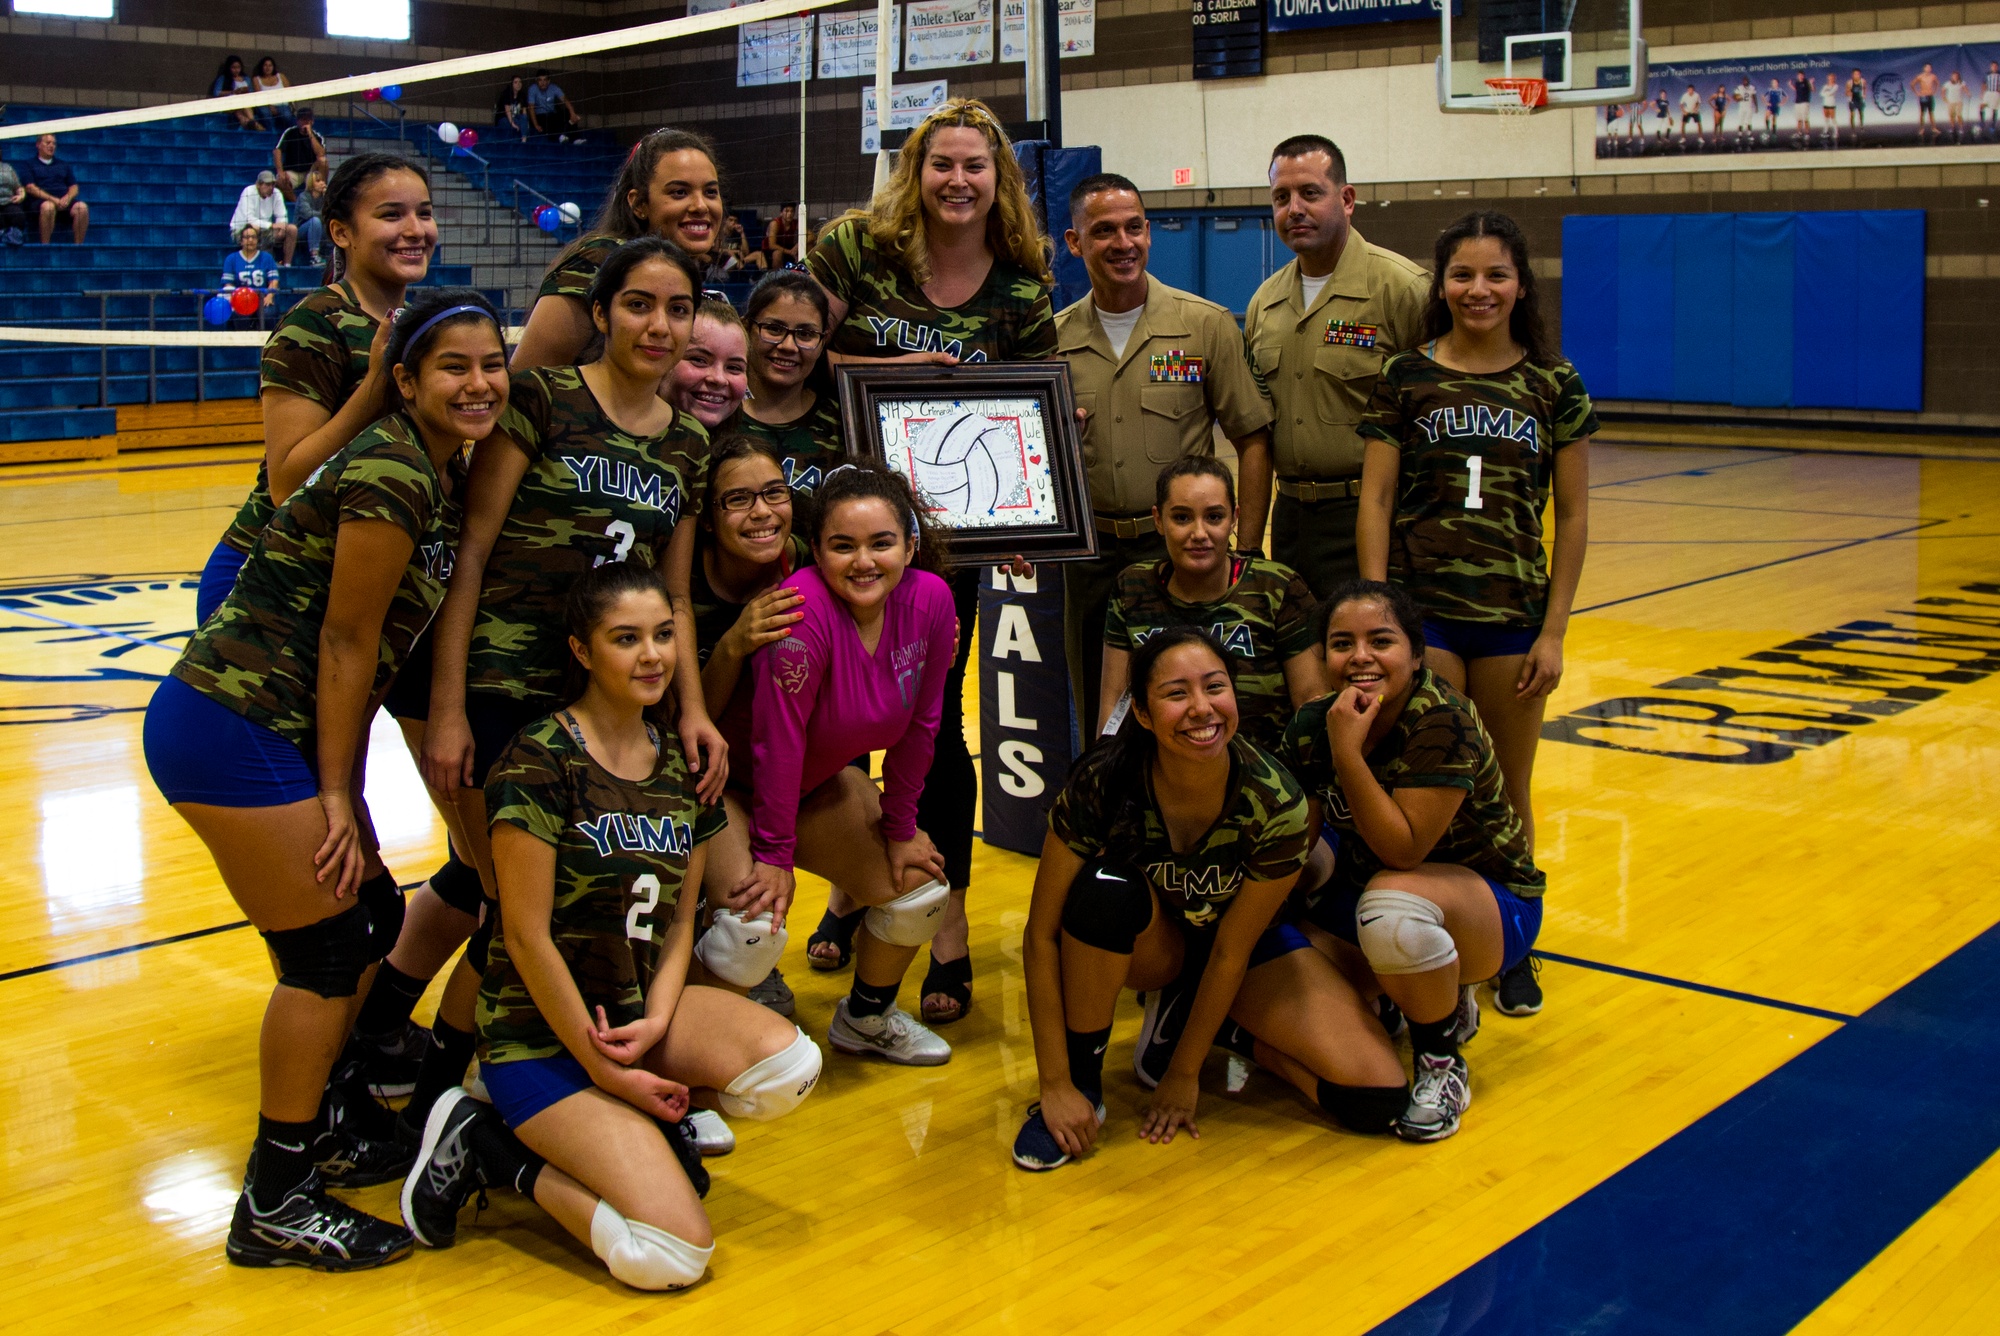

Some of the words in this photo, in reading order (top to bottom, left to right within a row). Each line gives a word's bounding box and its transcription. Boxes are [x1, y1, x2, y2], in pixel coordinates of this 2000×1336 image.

[1004, 2, 1025, 16] Athl
[1059, 0, 1076, 11] ear
[1194, 2, 1203, 12] 18
[910, 13, 943, 27] Athlete
[952, 10, 976, 23] Year
[1193, 14, 1206, 25] 00
[1211, 11, 1240, 24] SORIA
[1750, 63, 1764, 72] and
[1766, 61, 1789, 71] North
[1791, 60, 1808, 69] Side
[1175, 168, 1191, 184] EXIT
[239, 270, 264, 287] 56
[1414, 405, 1538, 453] YUMA
[1464, 455, 1483, 509] 1
[561, 455, 680, 527] YUMA
[575, 813, 693, 862] YUMA
[626, 873, 661, 941] 2
